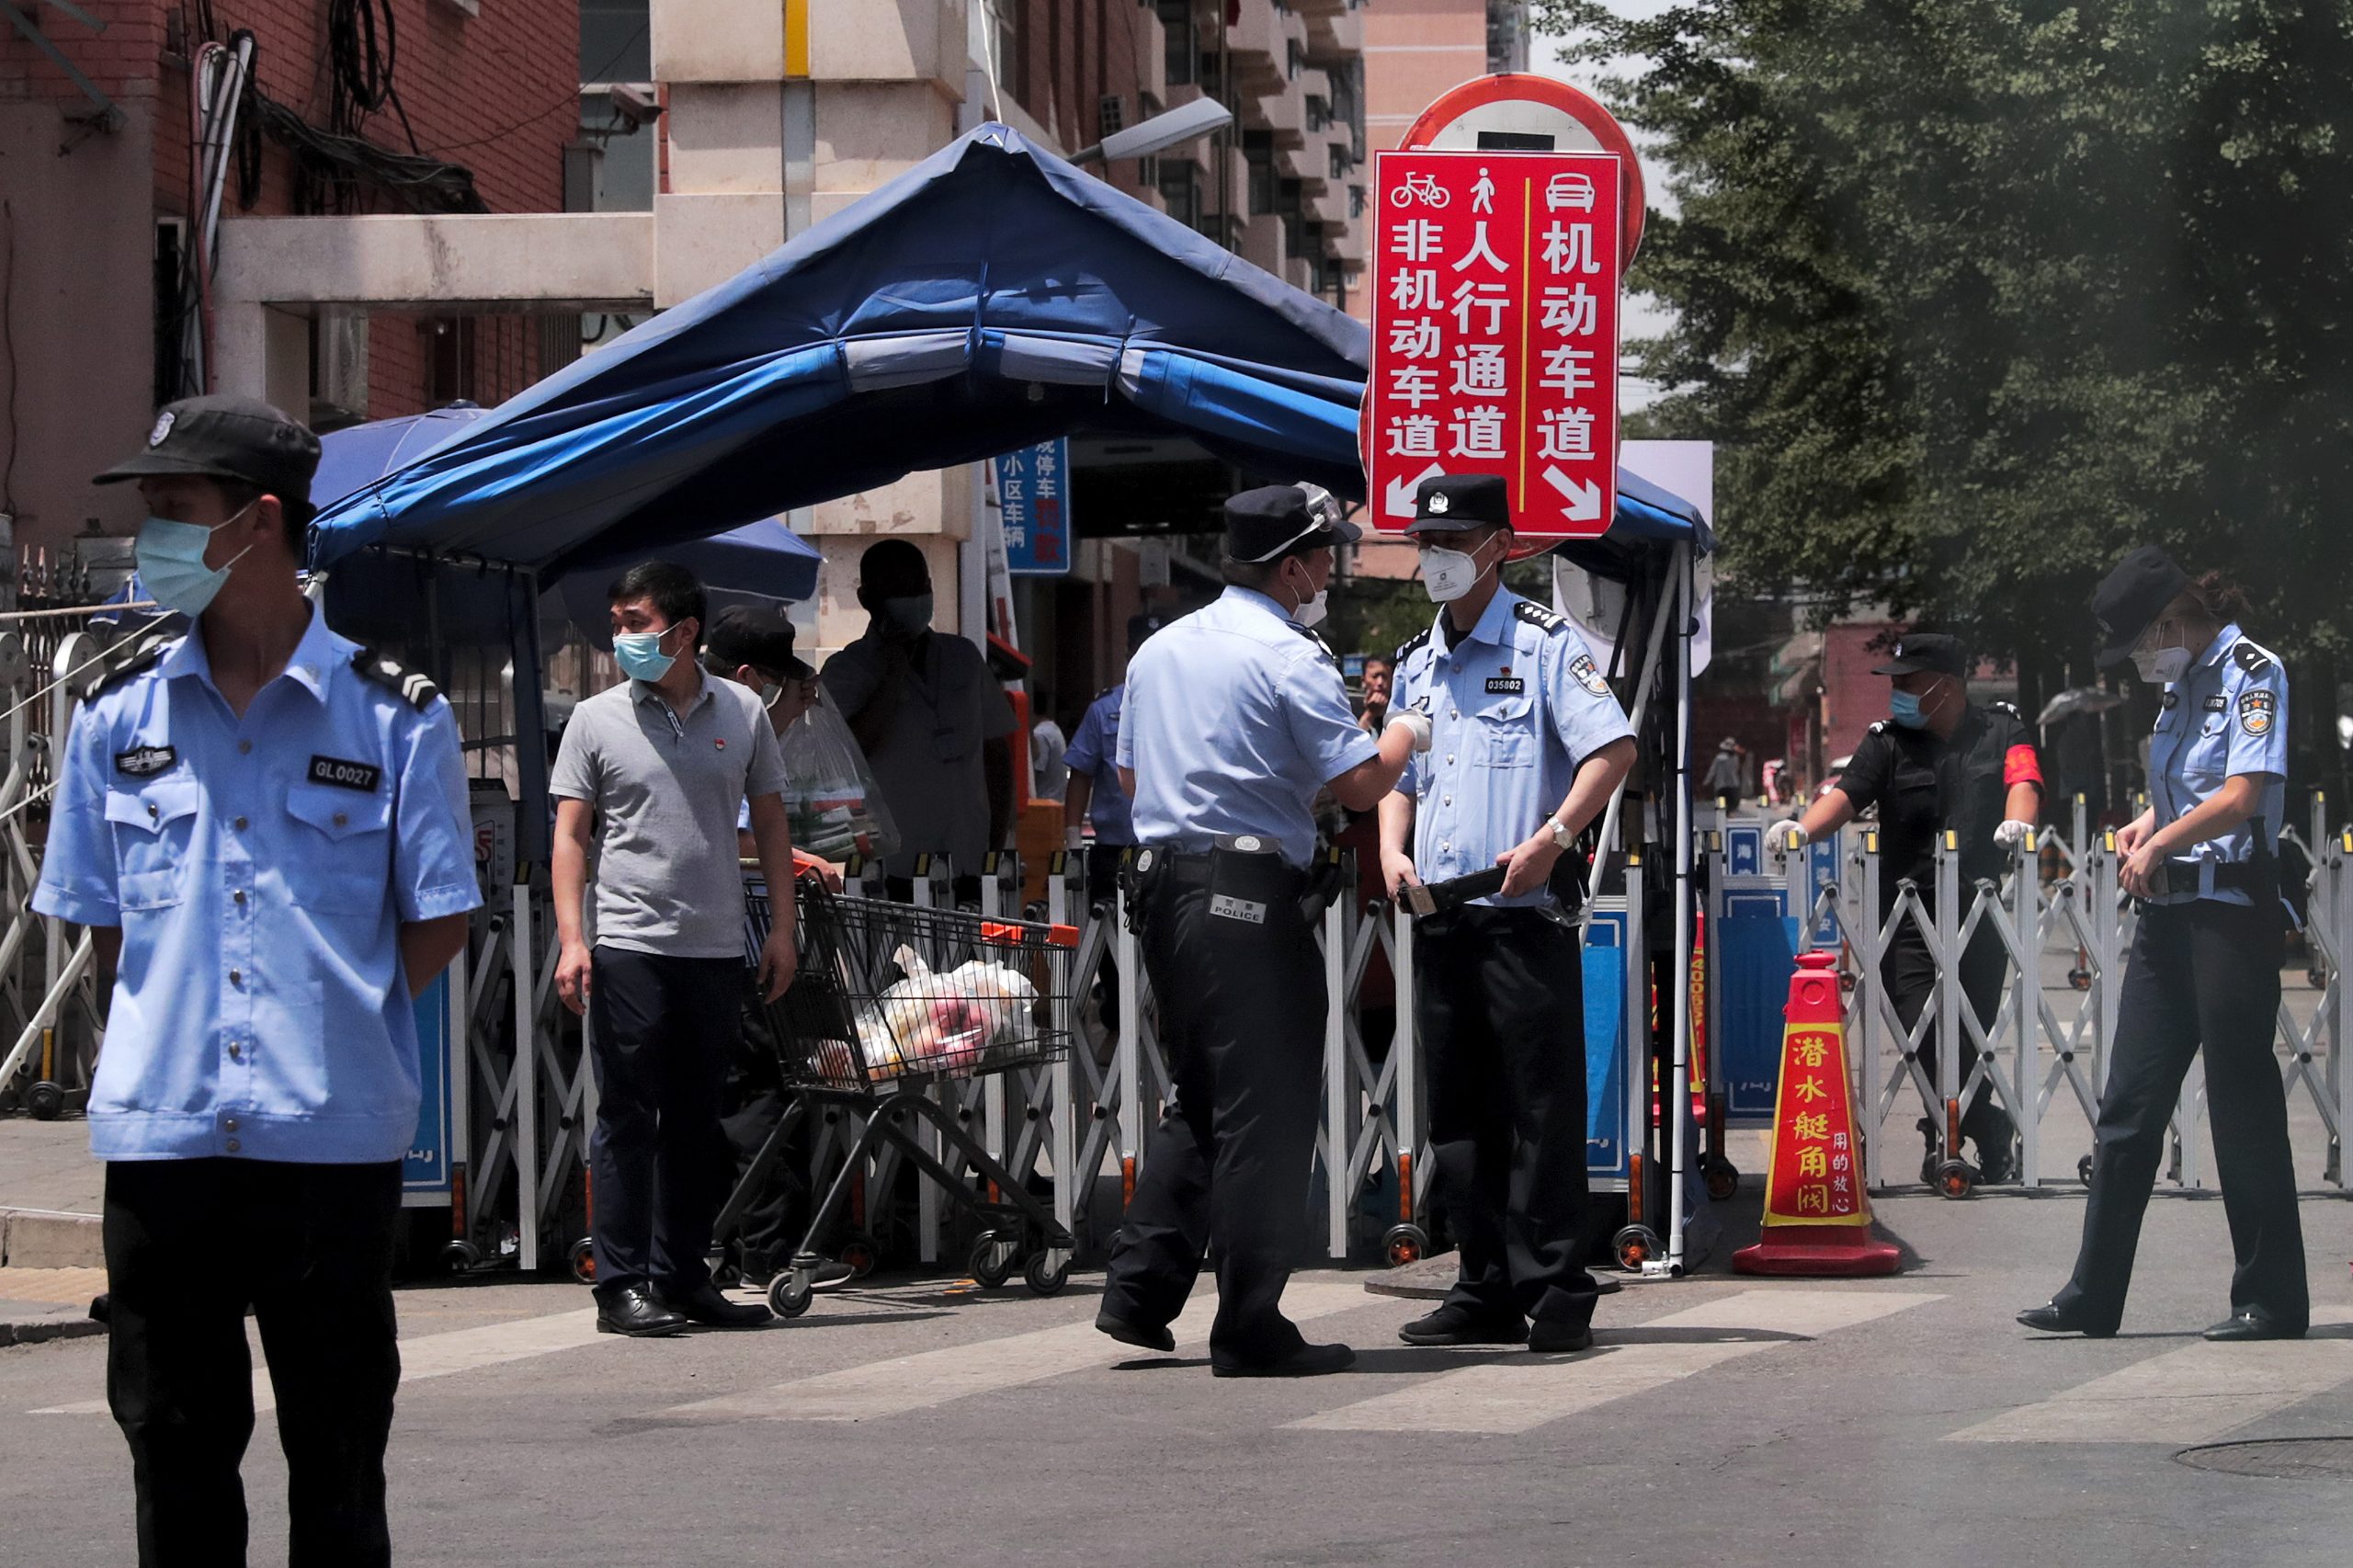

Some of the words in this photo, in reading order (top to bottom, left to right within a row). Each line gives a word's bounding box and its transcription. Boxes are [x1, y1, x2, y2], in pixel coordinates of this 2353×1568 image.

[1386, 219, 1444, 458] 非机动车道
[1448, 221, 1510, 460] 人行通道
[1537, 220, 1601, 460] 机动车道
[1003, 449, 1025, 549] 小区车辆
[1487, 680, 1521, 690] 035802
[315, 761, 372, 785] GL0027
[1214, 906, 1259, 921] POLICE
[1793, 1037, 1831, 1214] 潜水艇角阀
[1833, 1132, 1850, 1213] 用的放心
